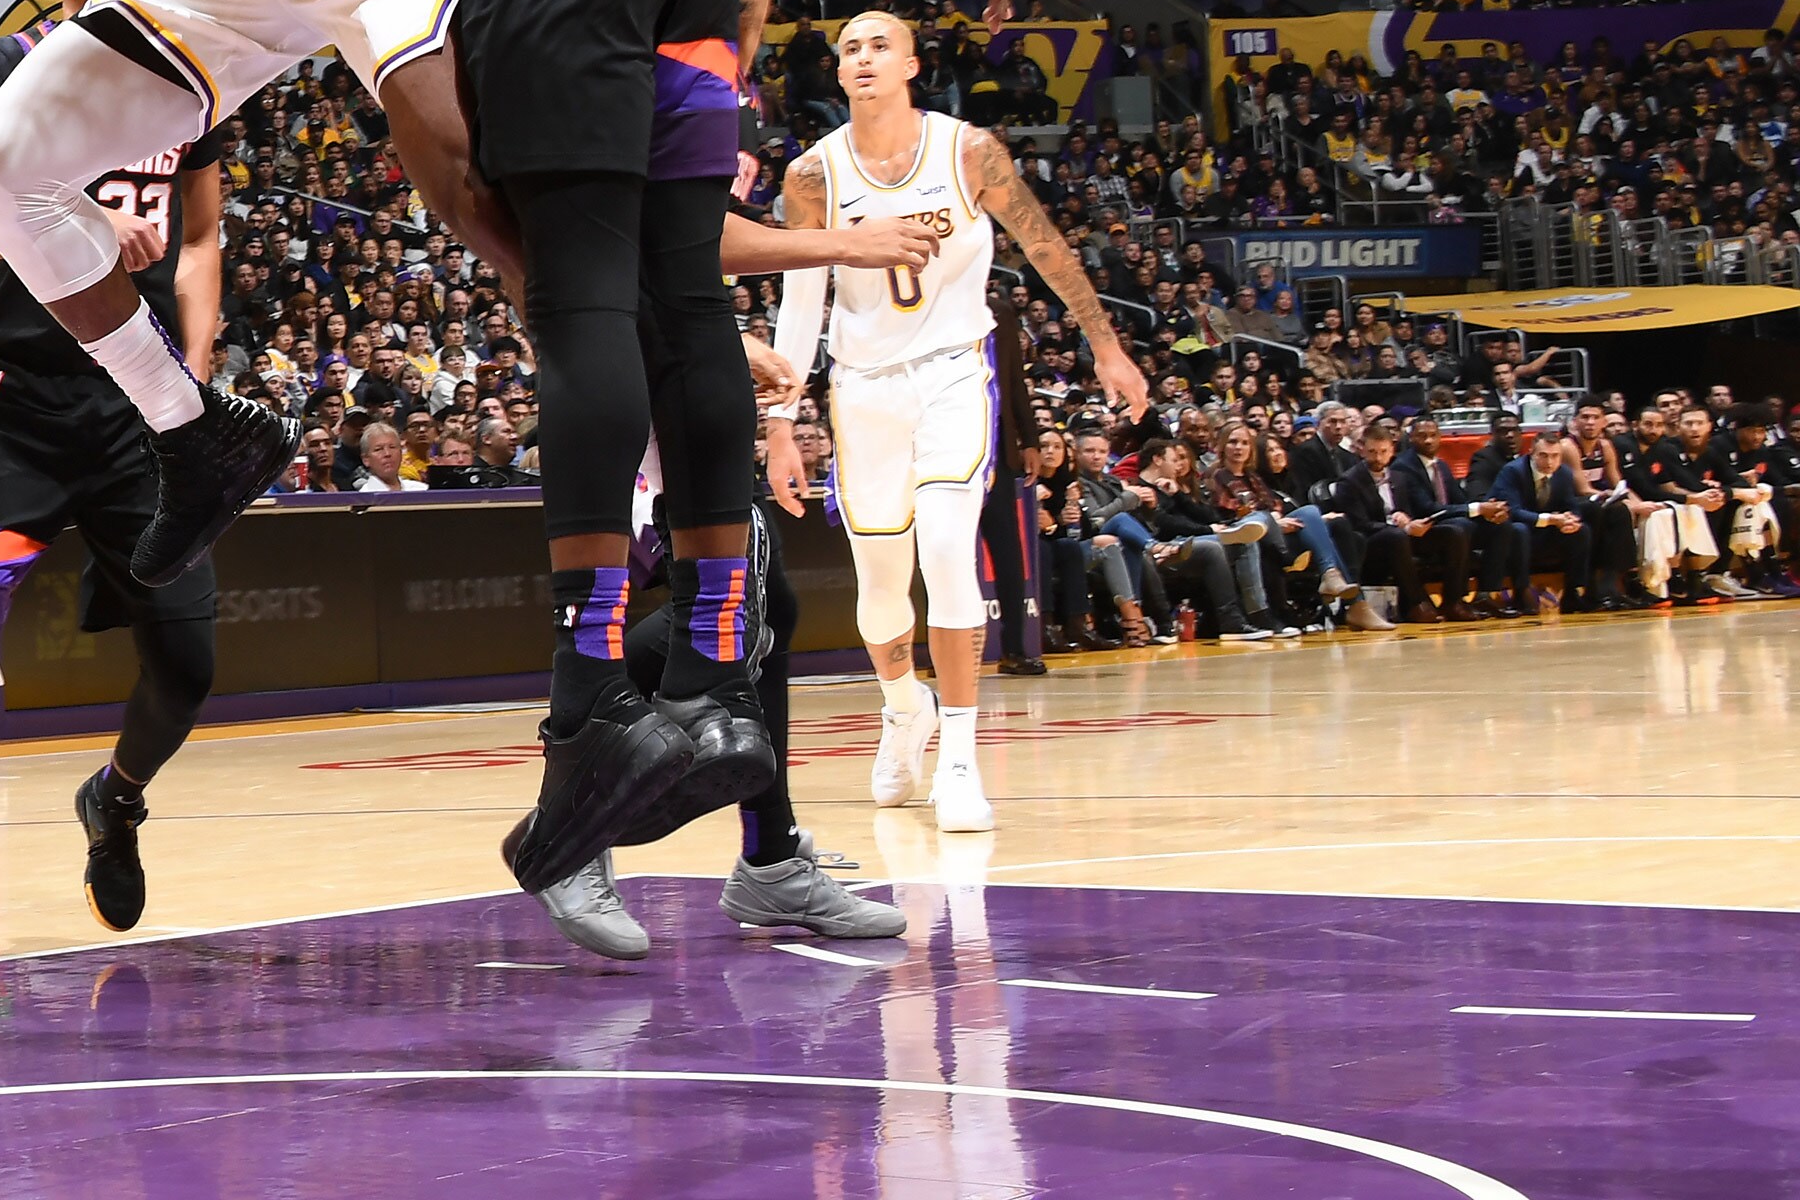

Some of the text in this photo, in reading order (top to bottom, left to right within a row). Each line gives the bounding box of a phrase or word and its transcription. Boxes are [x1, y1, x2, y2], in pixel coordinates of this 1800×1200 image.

[1231, 31, 1269, 54] 105
[1245, 239, 1421, 268] BUD LIGHT
[405, 578, 525, 614] WELCOME
